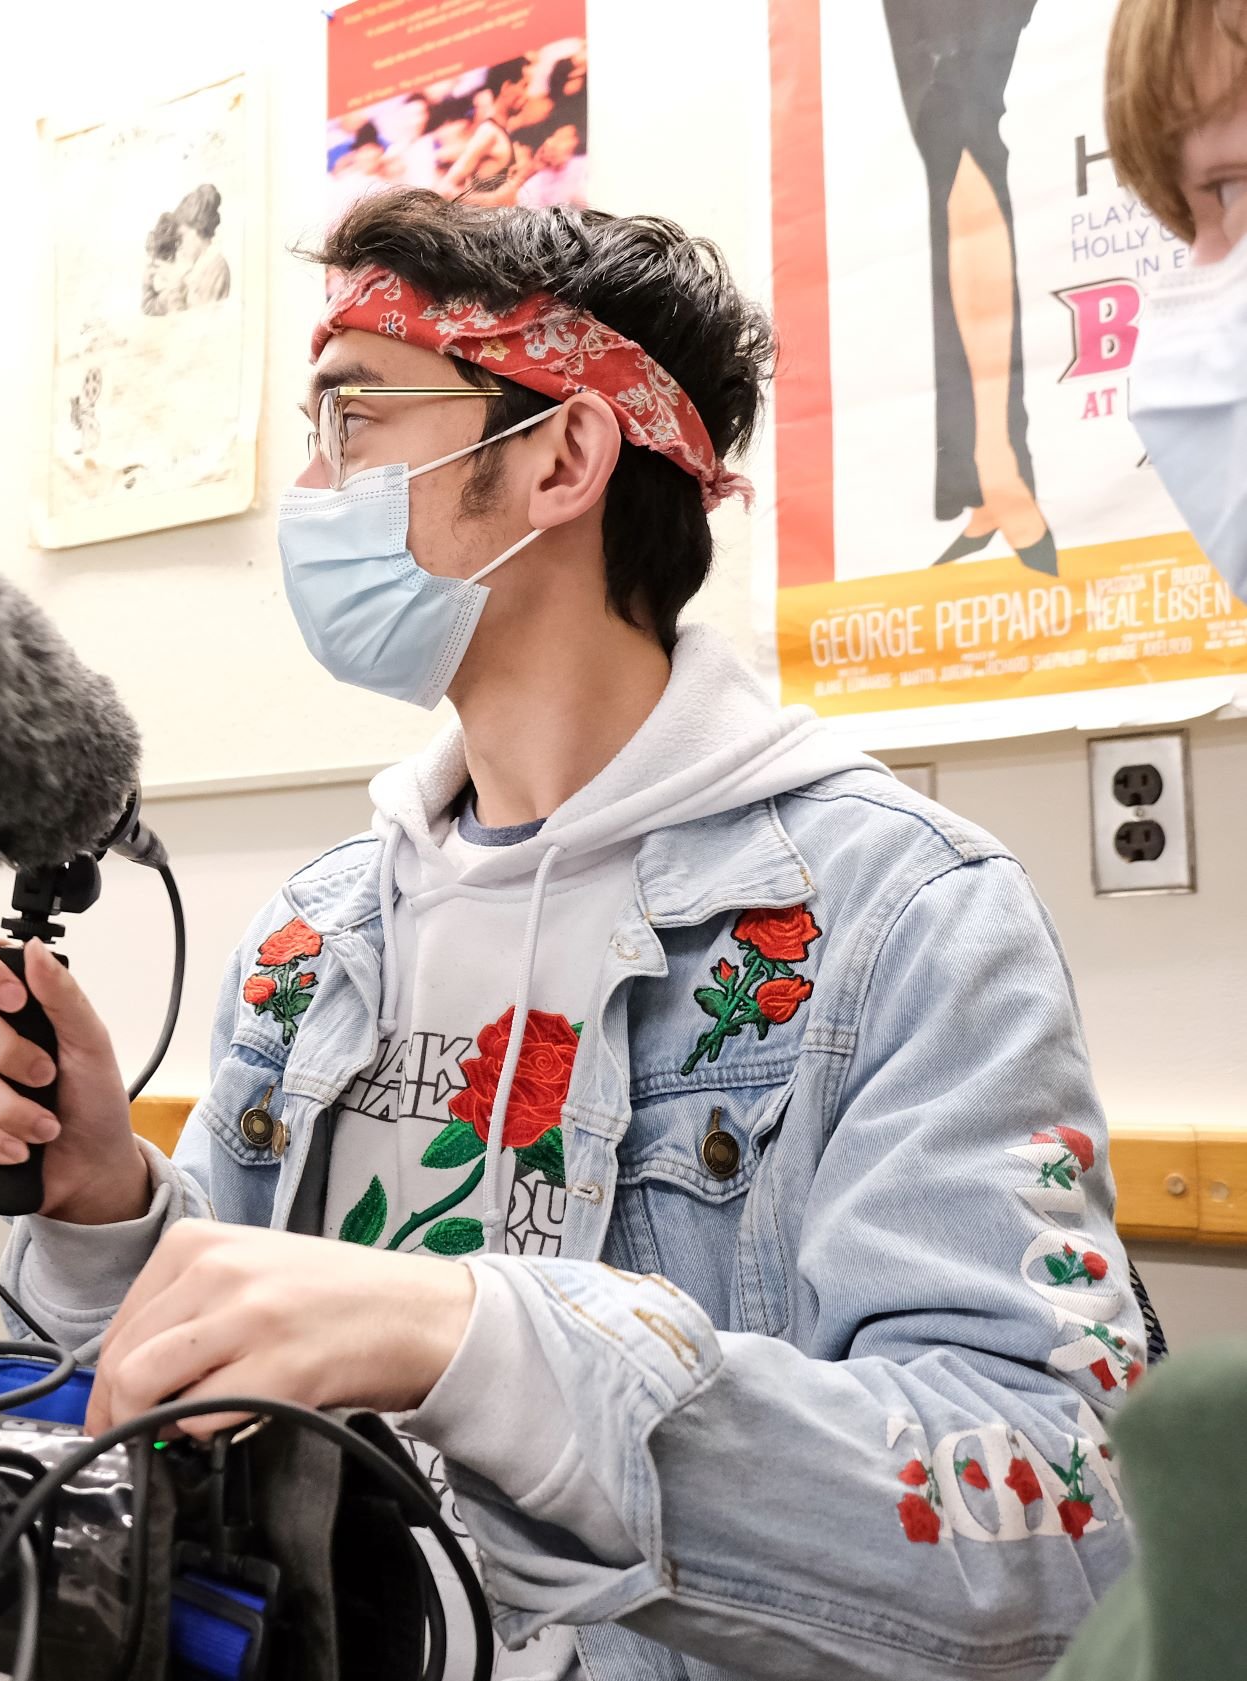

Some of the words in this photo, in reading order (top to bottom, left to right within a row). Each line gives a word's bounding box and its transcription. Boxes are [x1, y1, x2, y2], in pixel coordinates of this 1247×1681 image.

[1075, 134, 1121, 197] H
[1071, 226, 1149, 263] HOLLY
[1136, 255, 1160, 277] IN
[1173, 247, 1192, 268] E
[1053, 278, 1144, 383] B
[1081, 388, 1118, 420] AT
[810, 604, 926, 668] GEORGE
[935, 585, 1072, 652] PEPPARD
[1085, 579, 1144, 633] NEAL
[1153, 569, 1232, 625] EBSEN
